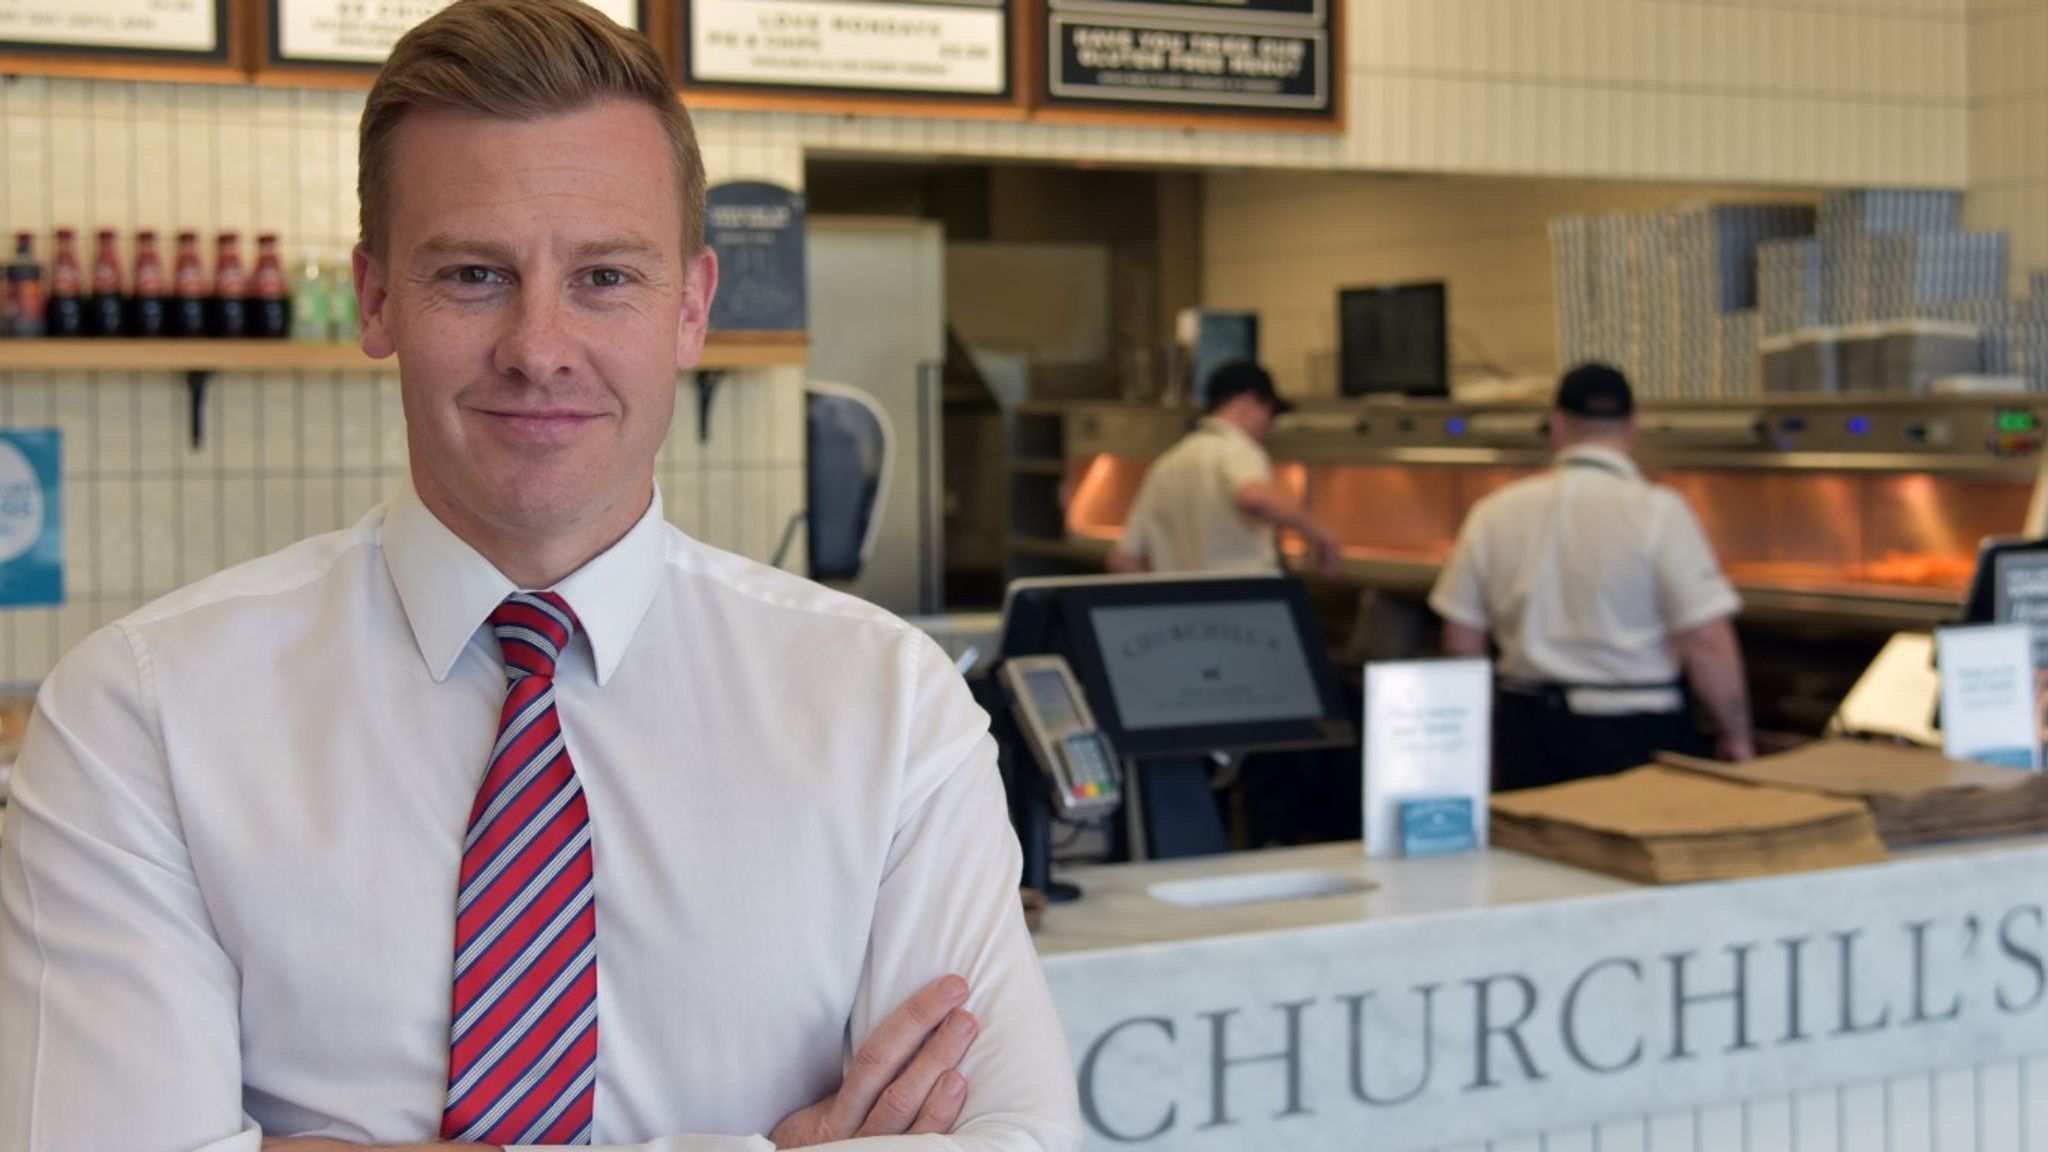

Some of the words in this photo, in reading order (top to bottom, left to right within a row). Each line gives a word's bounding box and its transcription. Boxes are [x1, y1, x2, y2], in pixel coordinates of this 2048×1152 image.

[758, 12, 820, 30] LOVE
[831, 15, 942, 36] MONDAYS
[1073, 27, 1134, 47] HAVE
[1137, 29, 1185, 50] YOU
[1190, 32, 1255, 53] TRIED
[1258, 36, 1306, 57] OUR
[1077, 48, 1166, 69] GLUTEN
[1169, 51, 1225, 73] FREE
[1077, 903, 2046, 1144] CHURCHILL'S
